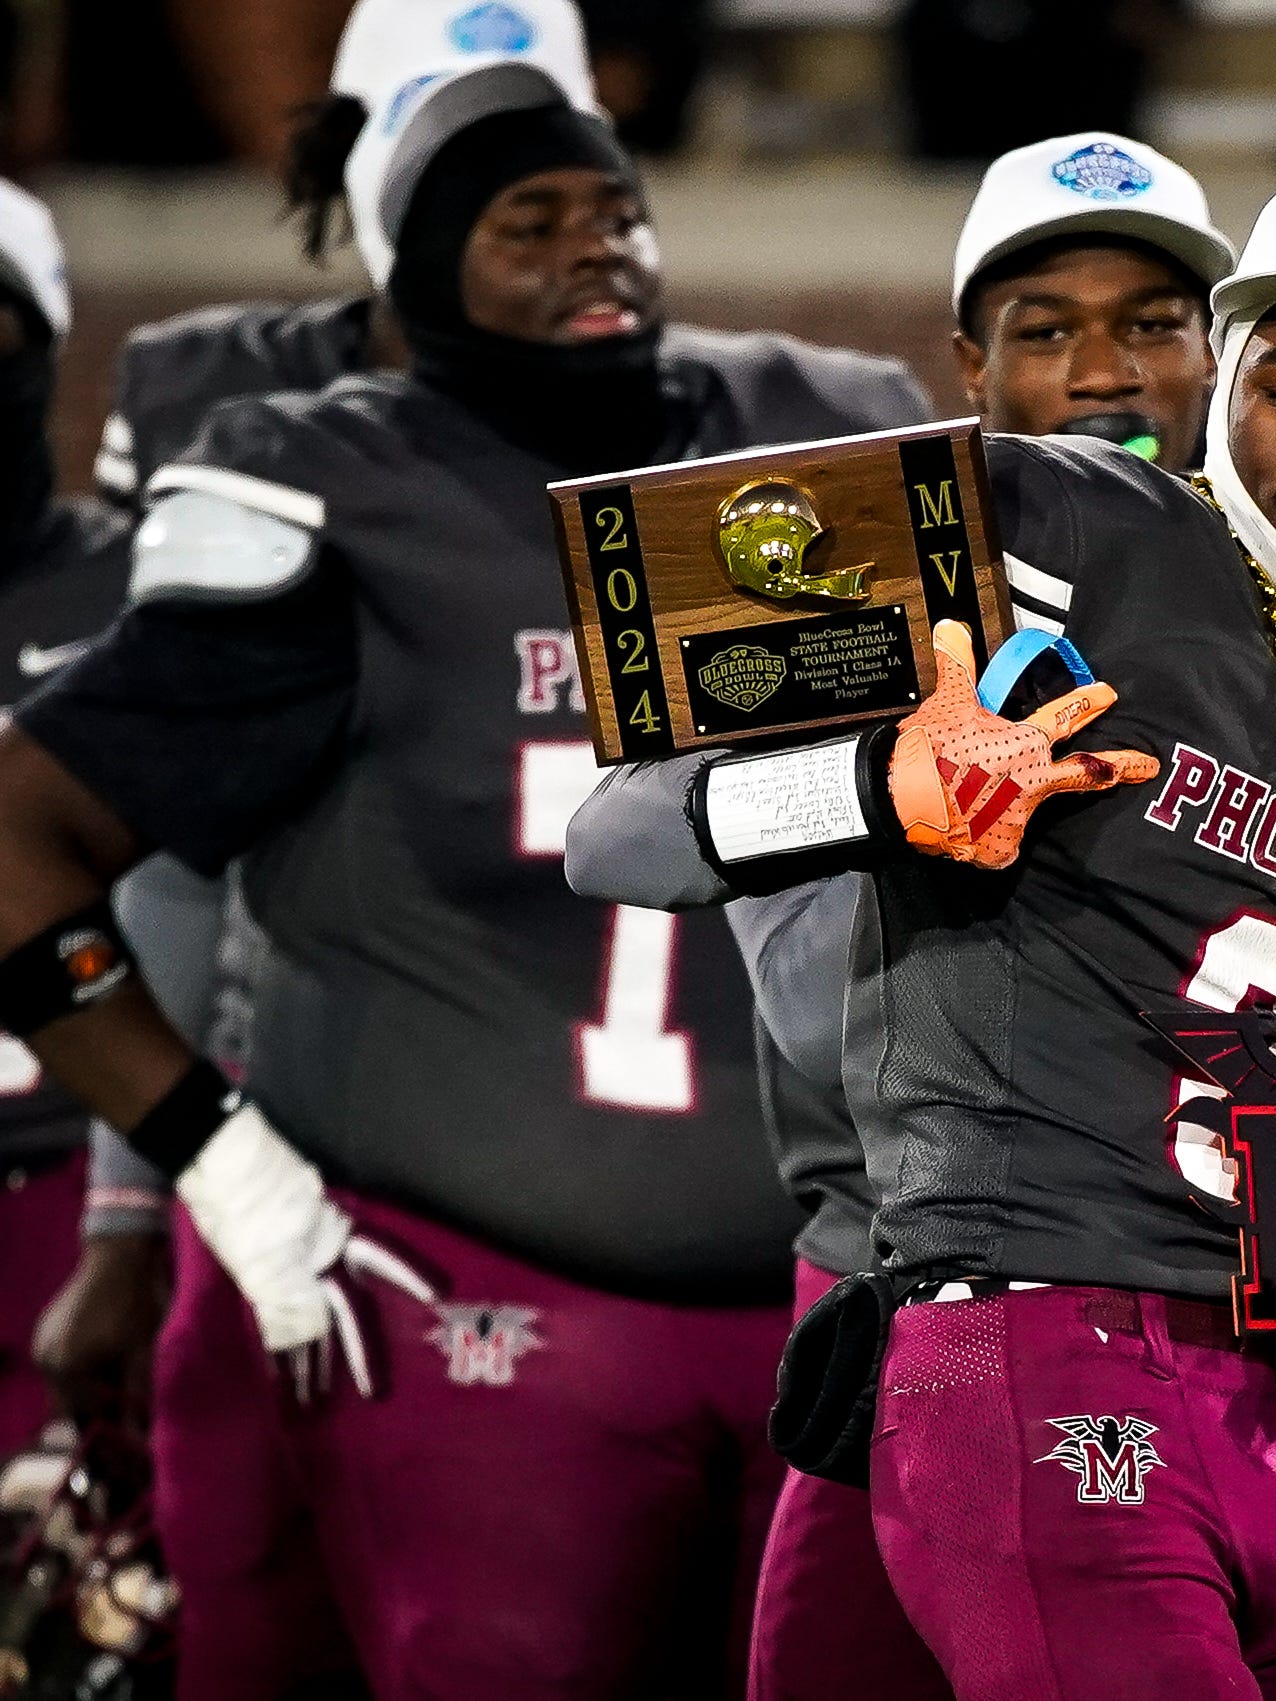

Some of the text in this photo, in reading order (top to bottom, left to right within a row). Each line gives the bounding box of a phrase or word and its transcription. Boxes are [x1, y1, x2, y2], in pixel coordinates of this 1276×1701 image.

[857, 620, 885, 634] Bowl
[789, 631, 898, 657] STATE FOOTBALL
[801, 645, 890, 667] TOURNAMENT
[702, 657, 783, 685] BLUECROSS
[794, 668, 839, 681] Division
[852, 660, 882, 672] Class
[811, 671, 889, 691] Most Valuable
[834, 687, 870, 700] Player
[1077, 1438, 1145, 1505] M
